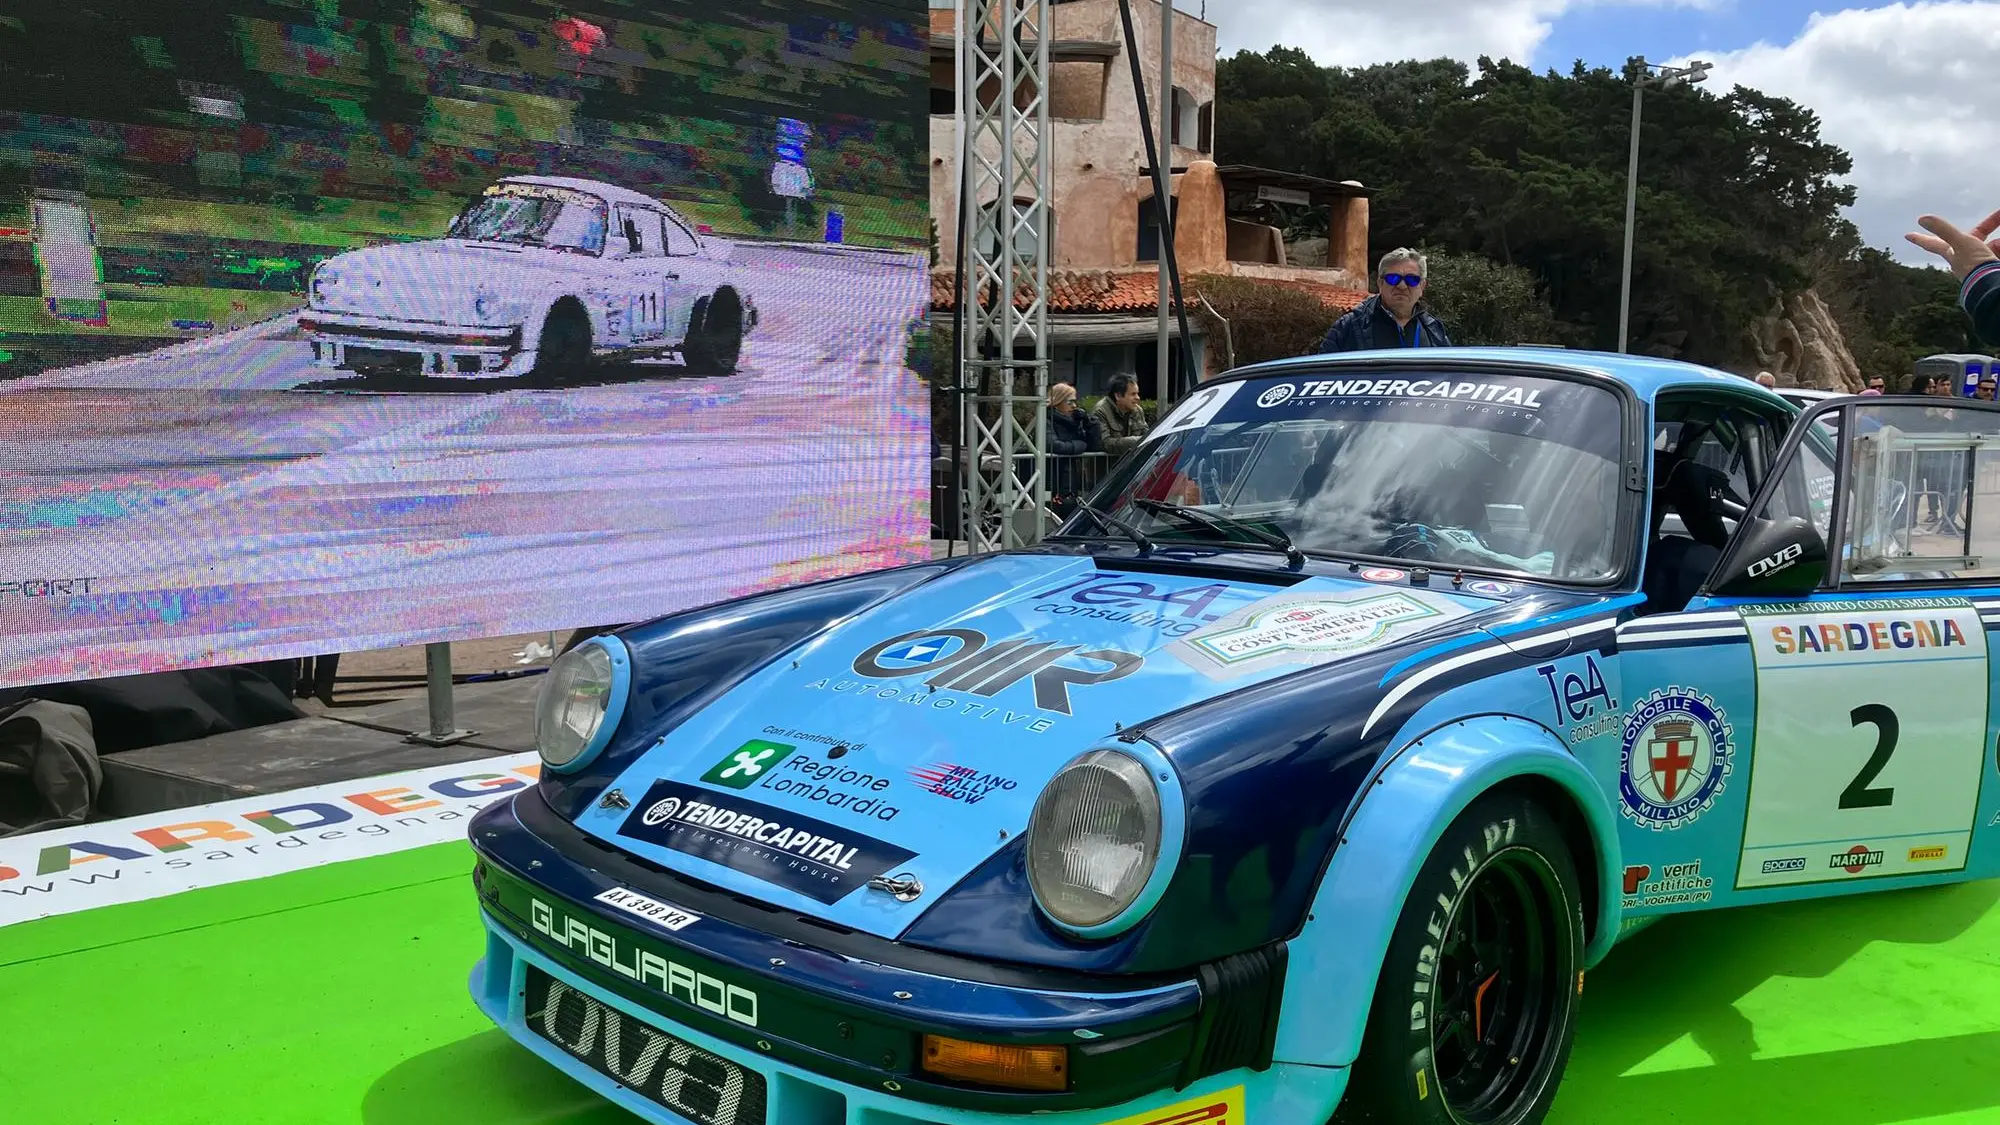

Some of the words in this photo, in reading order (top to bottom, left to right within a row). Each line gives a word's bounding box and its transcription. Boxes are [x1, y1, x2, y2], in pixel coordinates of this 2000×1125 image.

[1171, 387, 1220, 429] 2
[1298, 379, 1542, 408] TENDERCAPITAL
[1330, 399, 1449, 409] Investment
[1465, 404, 1533, 419] House
[1033, 603, 1202, 637] consulting
[1753, 603, 1797, 614] RALLY
[1799, 601, 1856, 612] STORICO
[1857, 599, 1900, 610] COSTA
[1899, 596, 1972, 608] SMERALDA
[1227, 629, 1298, 653] COSTA
[1301, 605, 1416, 635] SMERALDA
[1771, 619, 1967, 654] SARDEGNA
[805, 677, 1056, 733] AUTOMOTIVE
[762, 725, 784, 736] Con
[850, 741, 867, 751] di
[1568, 711, 1619, 744] consulting
[1619, 698, 1693, 774] AUTOMOBILE
[1708, 718, 1725, 767] CLUB
[1837, 702, 1900, 811] 2
[783, 755, 890, 792] Regione
[939, 774, 996, 796] RALLY
[949, 765, 1018, 790] MILANO
[760, 773, 900, 822] Lombardia
[928, 783, 985, 805] SHOW
[1638, 797, 1700, 820] MILANO
[0, 764, 541, 883] ARDEG
[676, 801, 859, 869] TENDERCAPITAL
[662, 823, 684, 835] The
[692, 830, 779, 863] Investment
[788, 860, 840, 883] House
[1663, 859, 1701, 878] verri
[1763, 858, 1805, 872] sparco
[1830, 851, 1883, 868] MARTINI
[1910, 848, 1945, 859] PIRELLI
[1644, 876, 1712, 894] rettifiche
[1644, 894, 1690, 906] VOGHERA
[1692, 891, 1712, 903] (PV)
[603, 890, 635, 904] AX
[626, 898, 666, 916] 398
[657, 911, 689, 926] XR
[1410, 845, 1478, 1031] PIRELLI
[531, 897, 758, 1027] GUAGLIARDO
